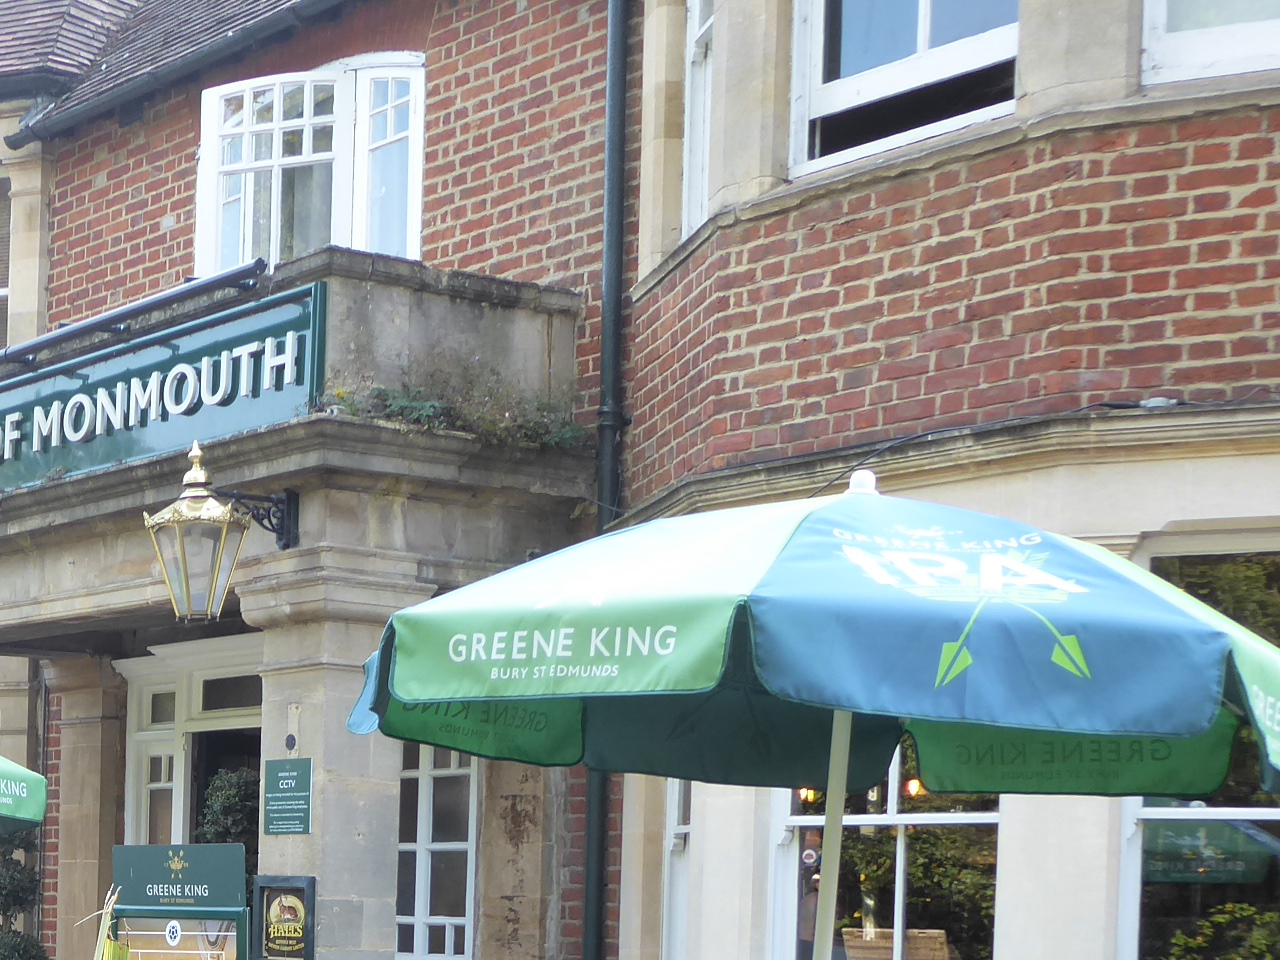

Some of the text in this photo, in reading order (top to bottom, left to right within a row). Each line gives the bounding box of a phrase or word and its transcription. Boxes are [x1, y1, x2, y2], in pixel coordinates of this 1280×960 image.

[33, 330, 299, 452] MONMOUTH
[961, 532, 1043, 549] KING
[448, 625, 678, 663] GREENE KING
[490, 664, 620, 681] BURY ST EDMUNDS
[0, 778, 27, 797] KING
[279, 780, 296, 789] CCTV
[146, 884, 209, 896] GREENE KING
